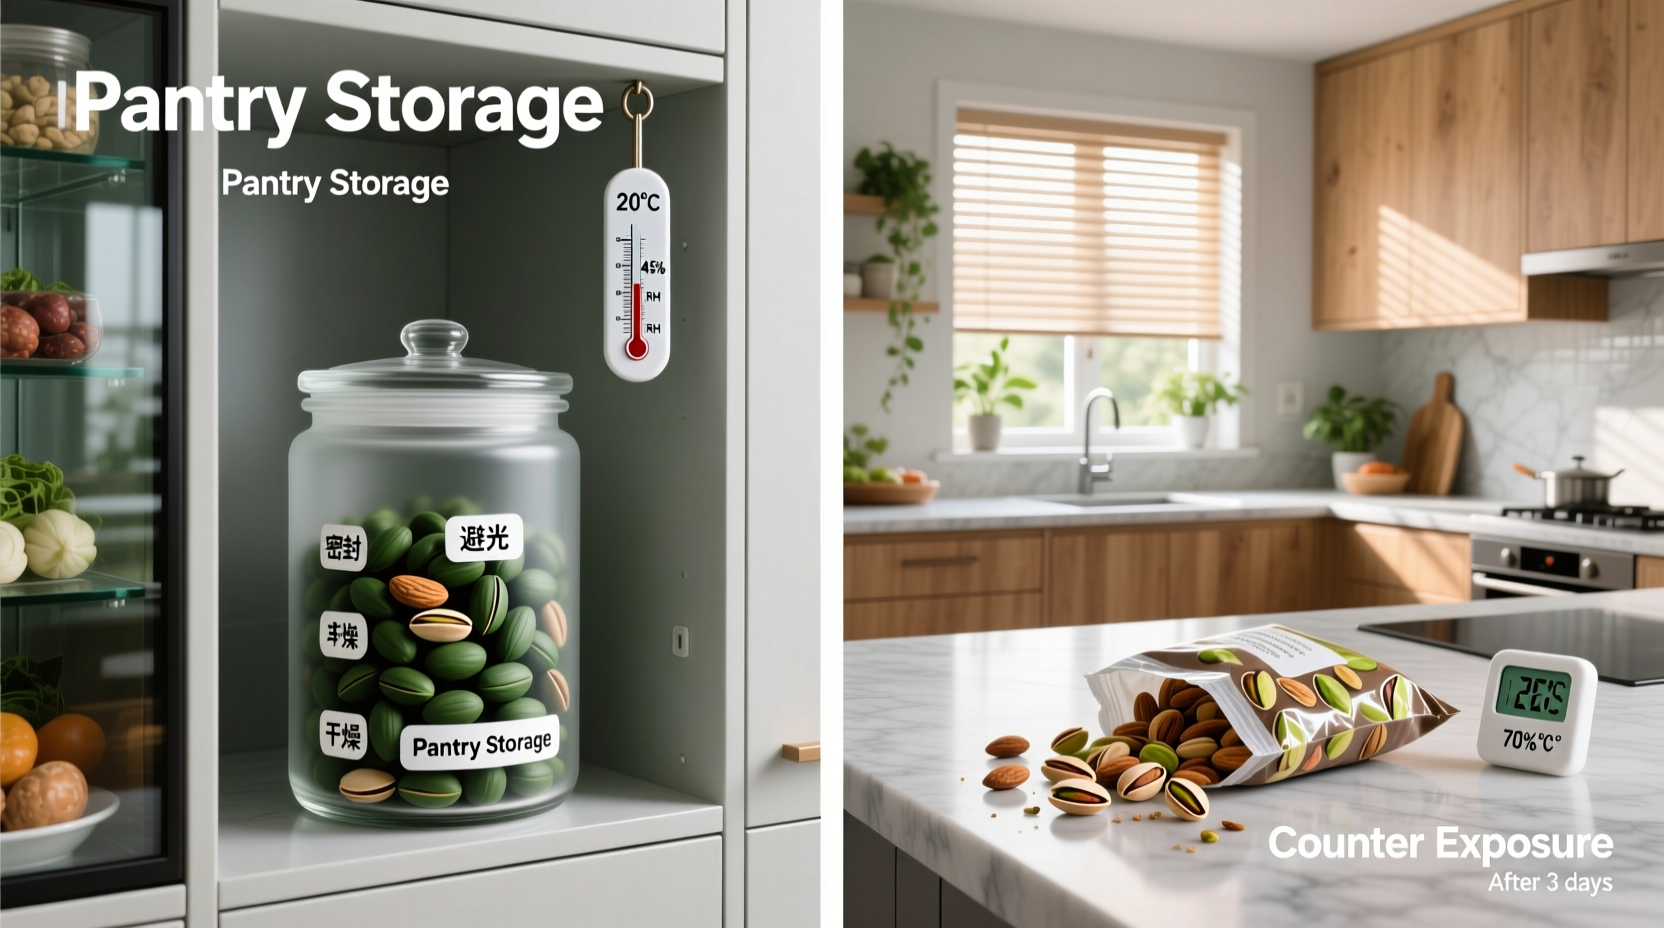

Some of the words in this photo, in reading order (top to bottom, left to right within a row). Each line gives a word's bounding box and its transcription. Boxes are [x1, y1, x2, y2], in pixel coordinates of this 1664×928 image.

[460, 523, 510, 552] 避光
[325, 721, 361, 752] 干燥
[412, 737, 481, 761] Pantry
[486, 732, 552, 754] Storage
